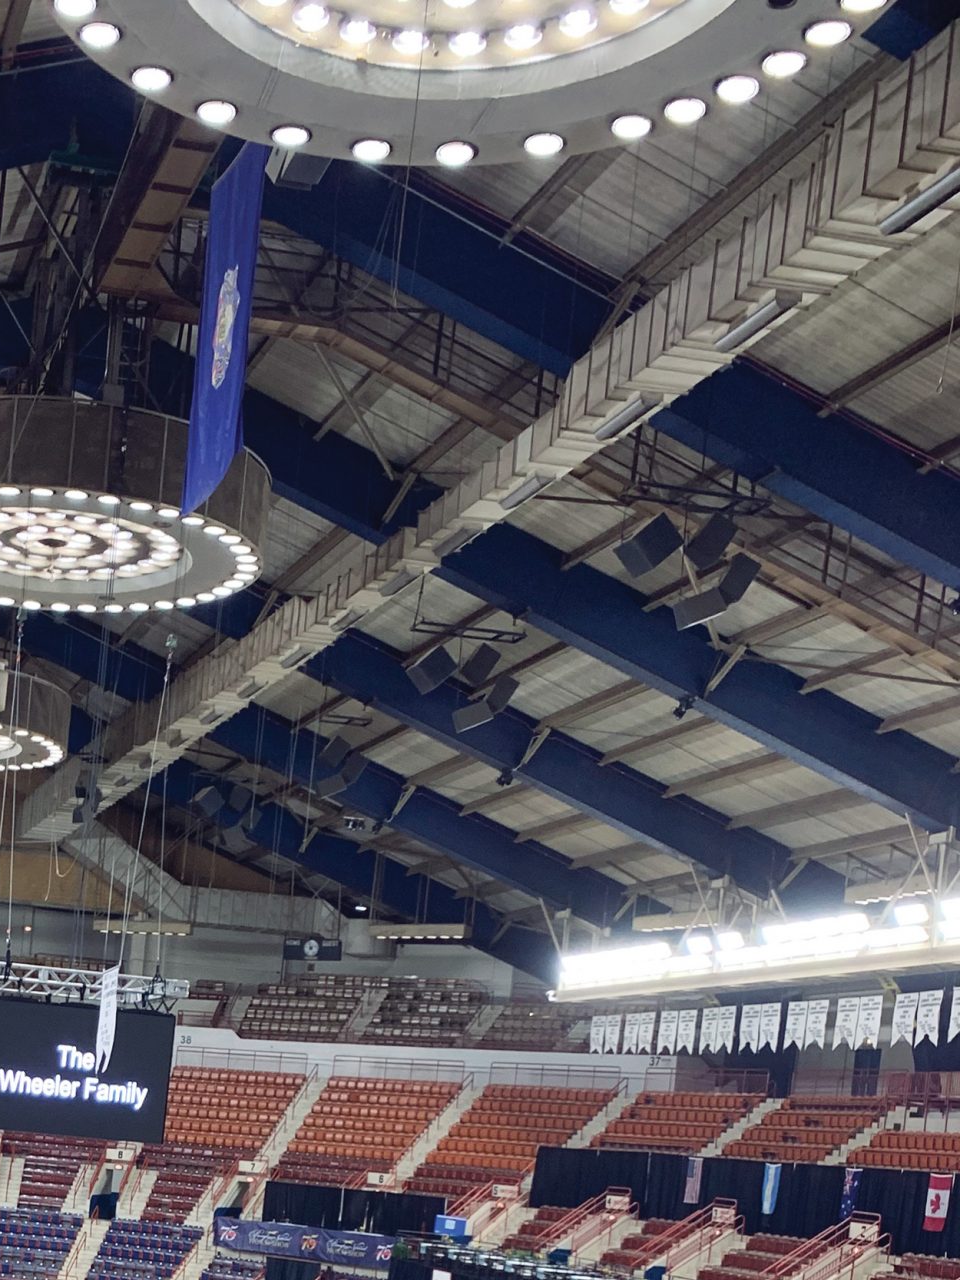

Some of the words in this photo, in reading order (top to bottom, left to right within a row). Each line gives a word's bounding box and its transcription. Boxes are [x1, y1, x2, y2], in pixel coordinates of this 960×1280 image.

[57, 1044, 96, 1070] The
[649, 1056, 661, 1066] 37
[83, 1077, 148, 1110] Family
[219, 1225, 239, 1241] 75
[301, 1234, 319, 1250] 75
[376, 1244, 394, 1261] 75
